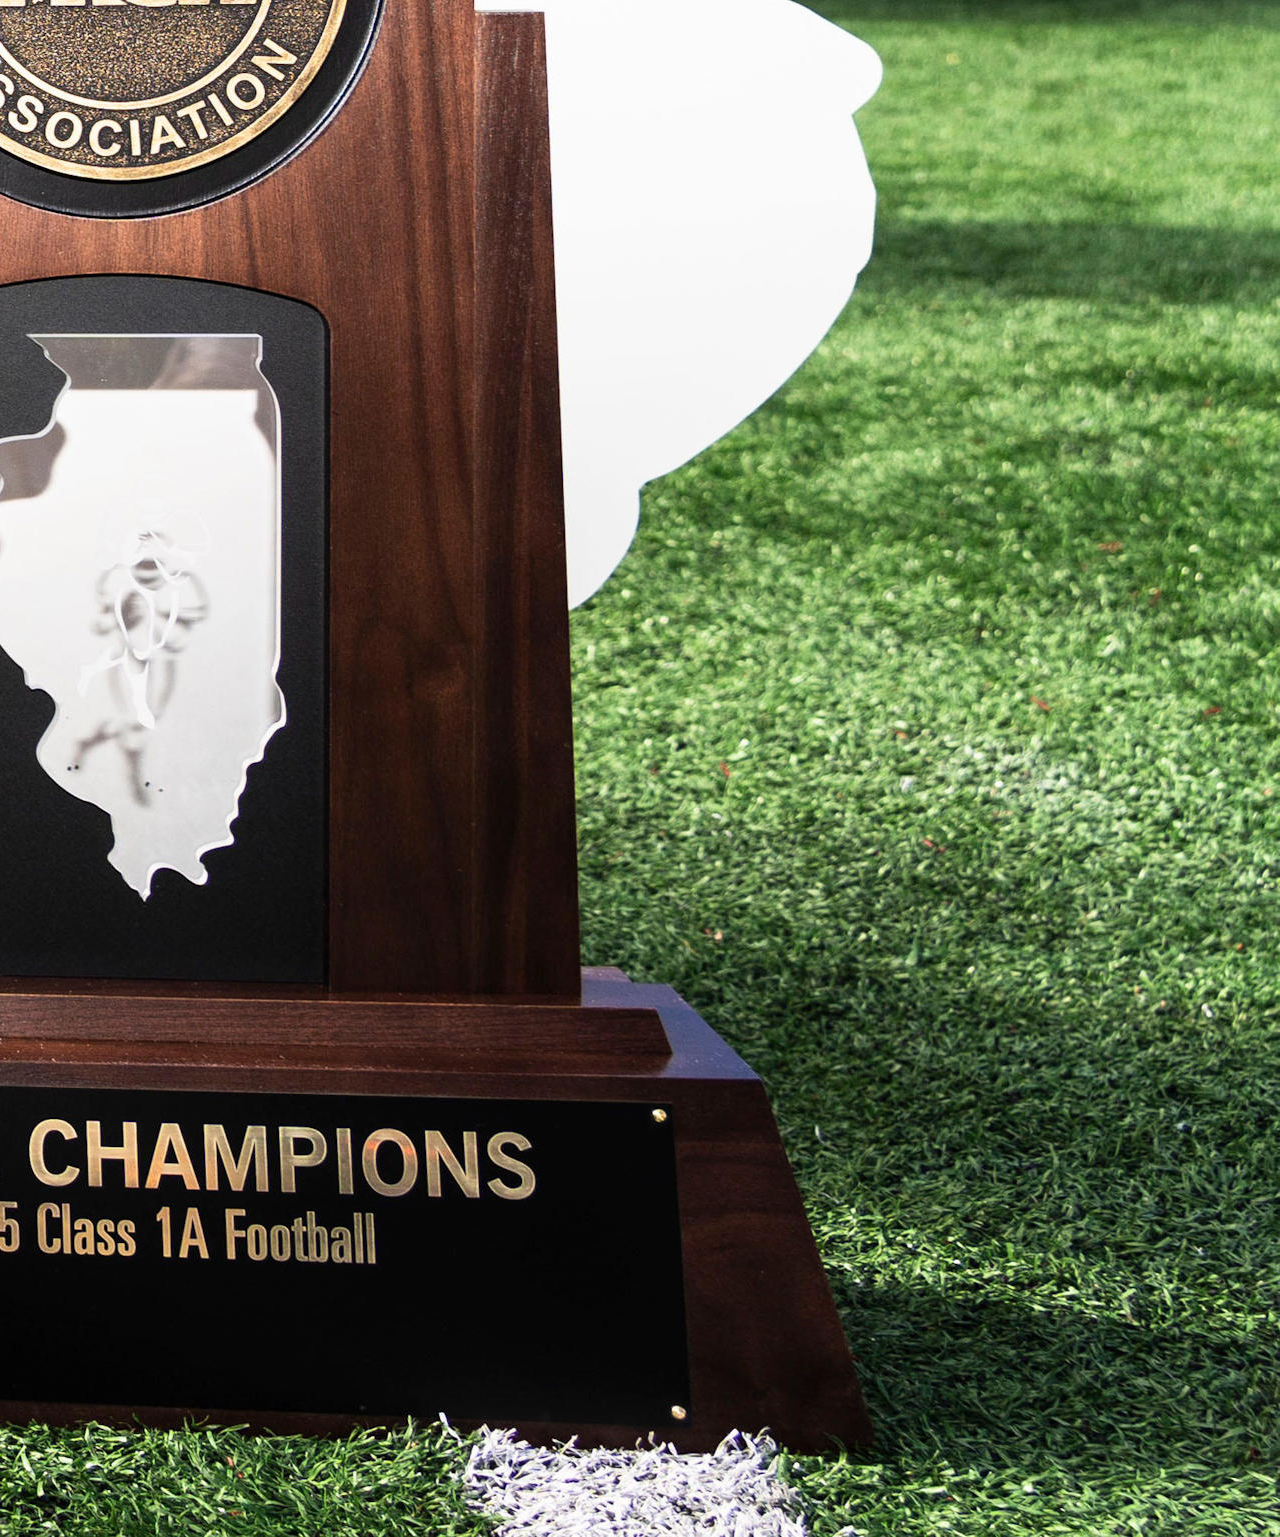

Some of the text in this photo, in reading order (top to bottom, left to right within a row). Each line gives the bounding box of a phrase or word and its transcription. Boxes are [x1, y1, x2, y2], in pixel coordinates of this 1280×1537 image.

[29, 1119, 537, 1200] CHAMPIONS
[37, 1202, 136, 1257] Class
[157, 1206, 209, 1259] 1A
[225, 1208, 377, 1265] Football
